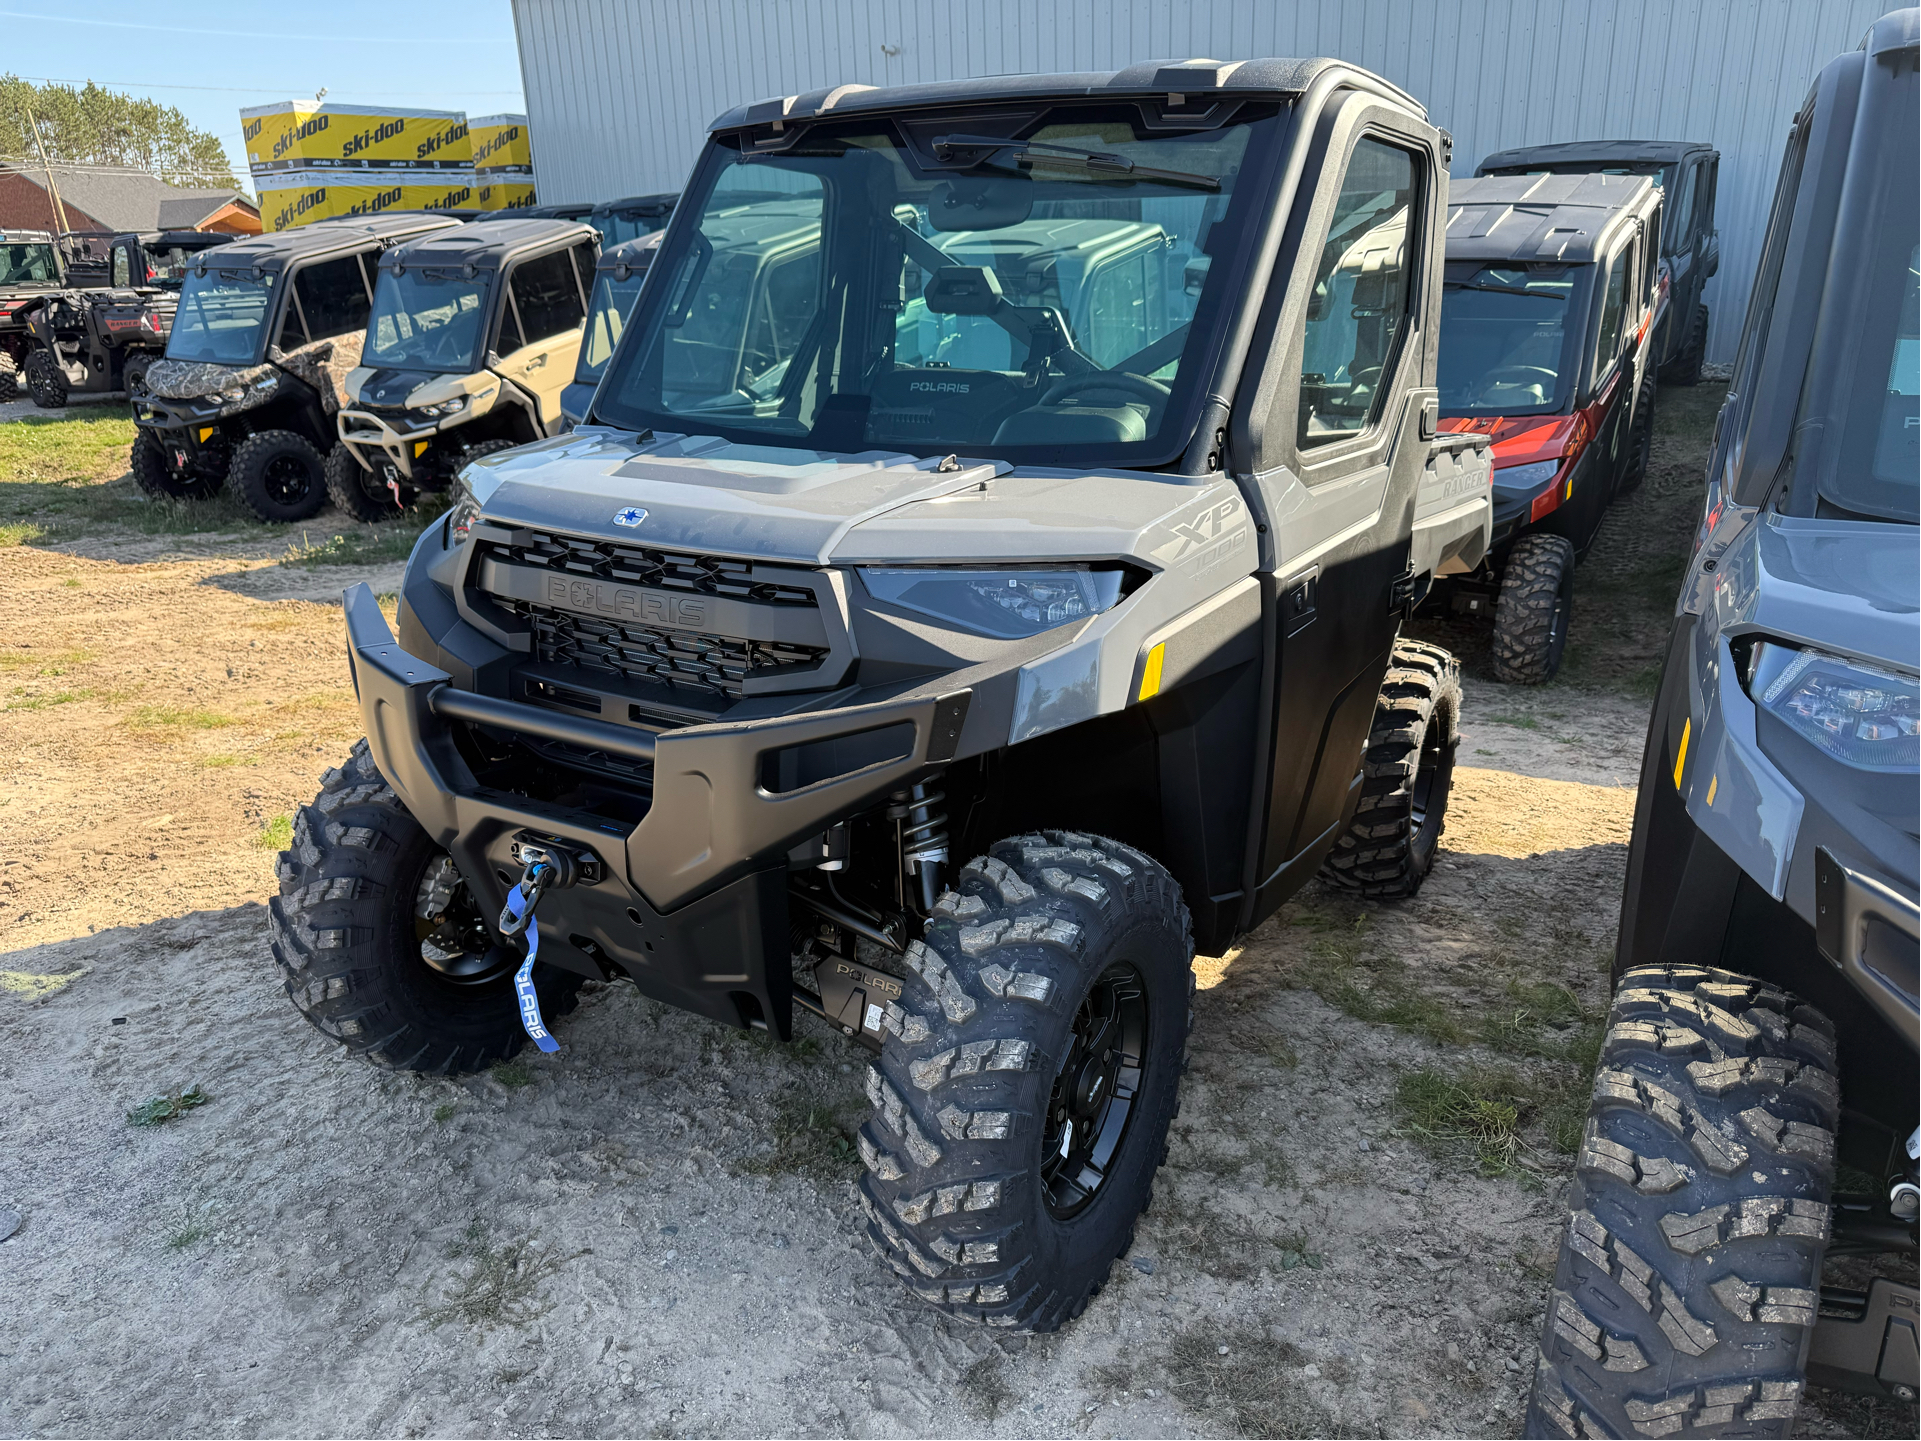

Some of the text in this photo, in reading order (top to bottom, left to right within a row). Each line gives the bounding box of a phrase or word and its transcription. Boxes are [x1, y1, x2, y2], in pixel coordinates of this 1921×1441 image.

[273, 115, 328, 159] ski-doo
[343, 118, 404, 157] ski-doo
[473, 126, 518, 166] ski-doo
[274, 188, 326, 232] ski-doo
[344, 187, 402, 215] ki-doo
[424, 187, 470, 210] i-doo
[910, 382, 970, 393] POLARIS
[1443, 470, 1484, 498] RANGER
[1168, 495, 1243, 561] XP
[548, 576, 706, 627] POLARIS
[517, 953, 547, 1039] POLARIS
[836, 963, 902, 997] POLARI
